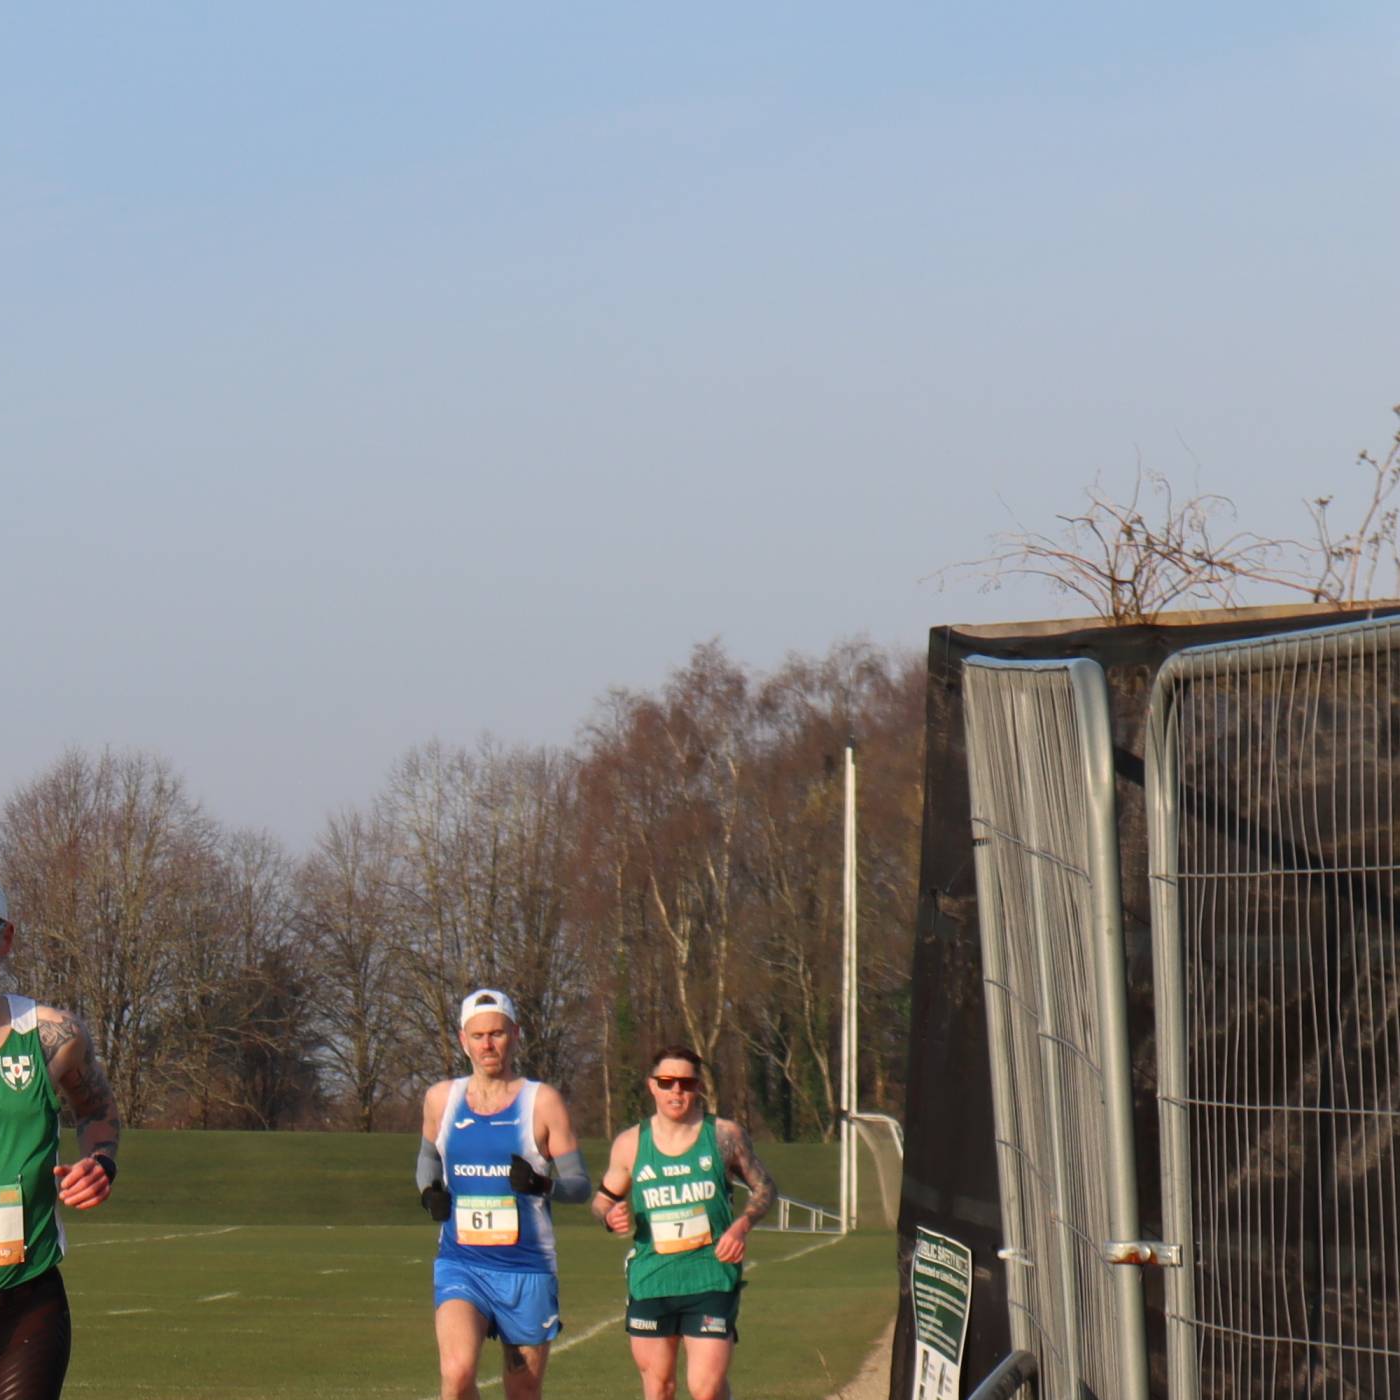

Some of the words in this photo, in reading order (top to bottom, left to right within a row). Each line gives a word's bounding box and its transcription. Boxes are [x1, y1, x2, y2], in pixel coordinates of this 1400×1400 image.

[642, 1181, 715, 1209] IRELAND
[472, 1211, 493, 1229] 61
[674, 1222, 684, 1238] 7
